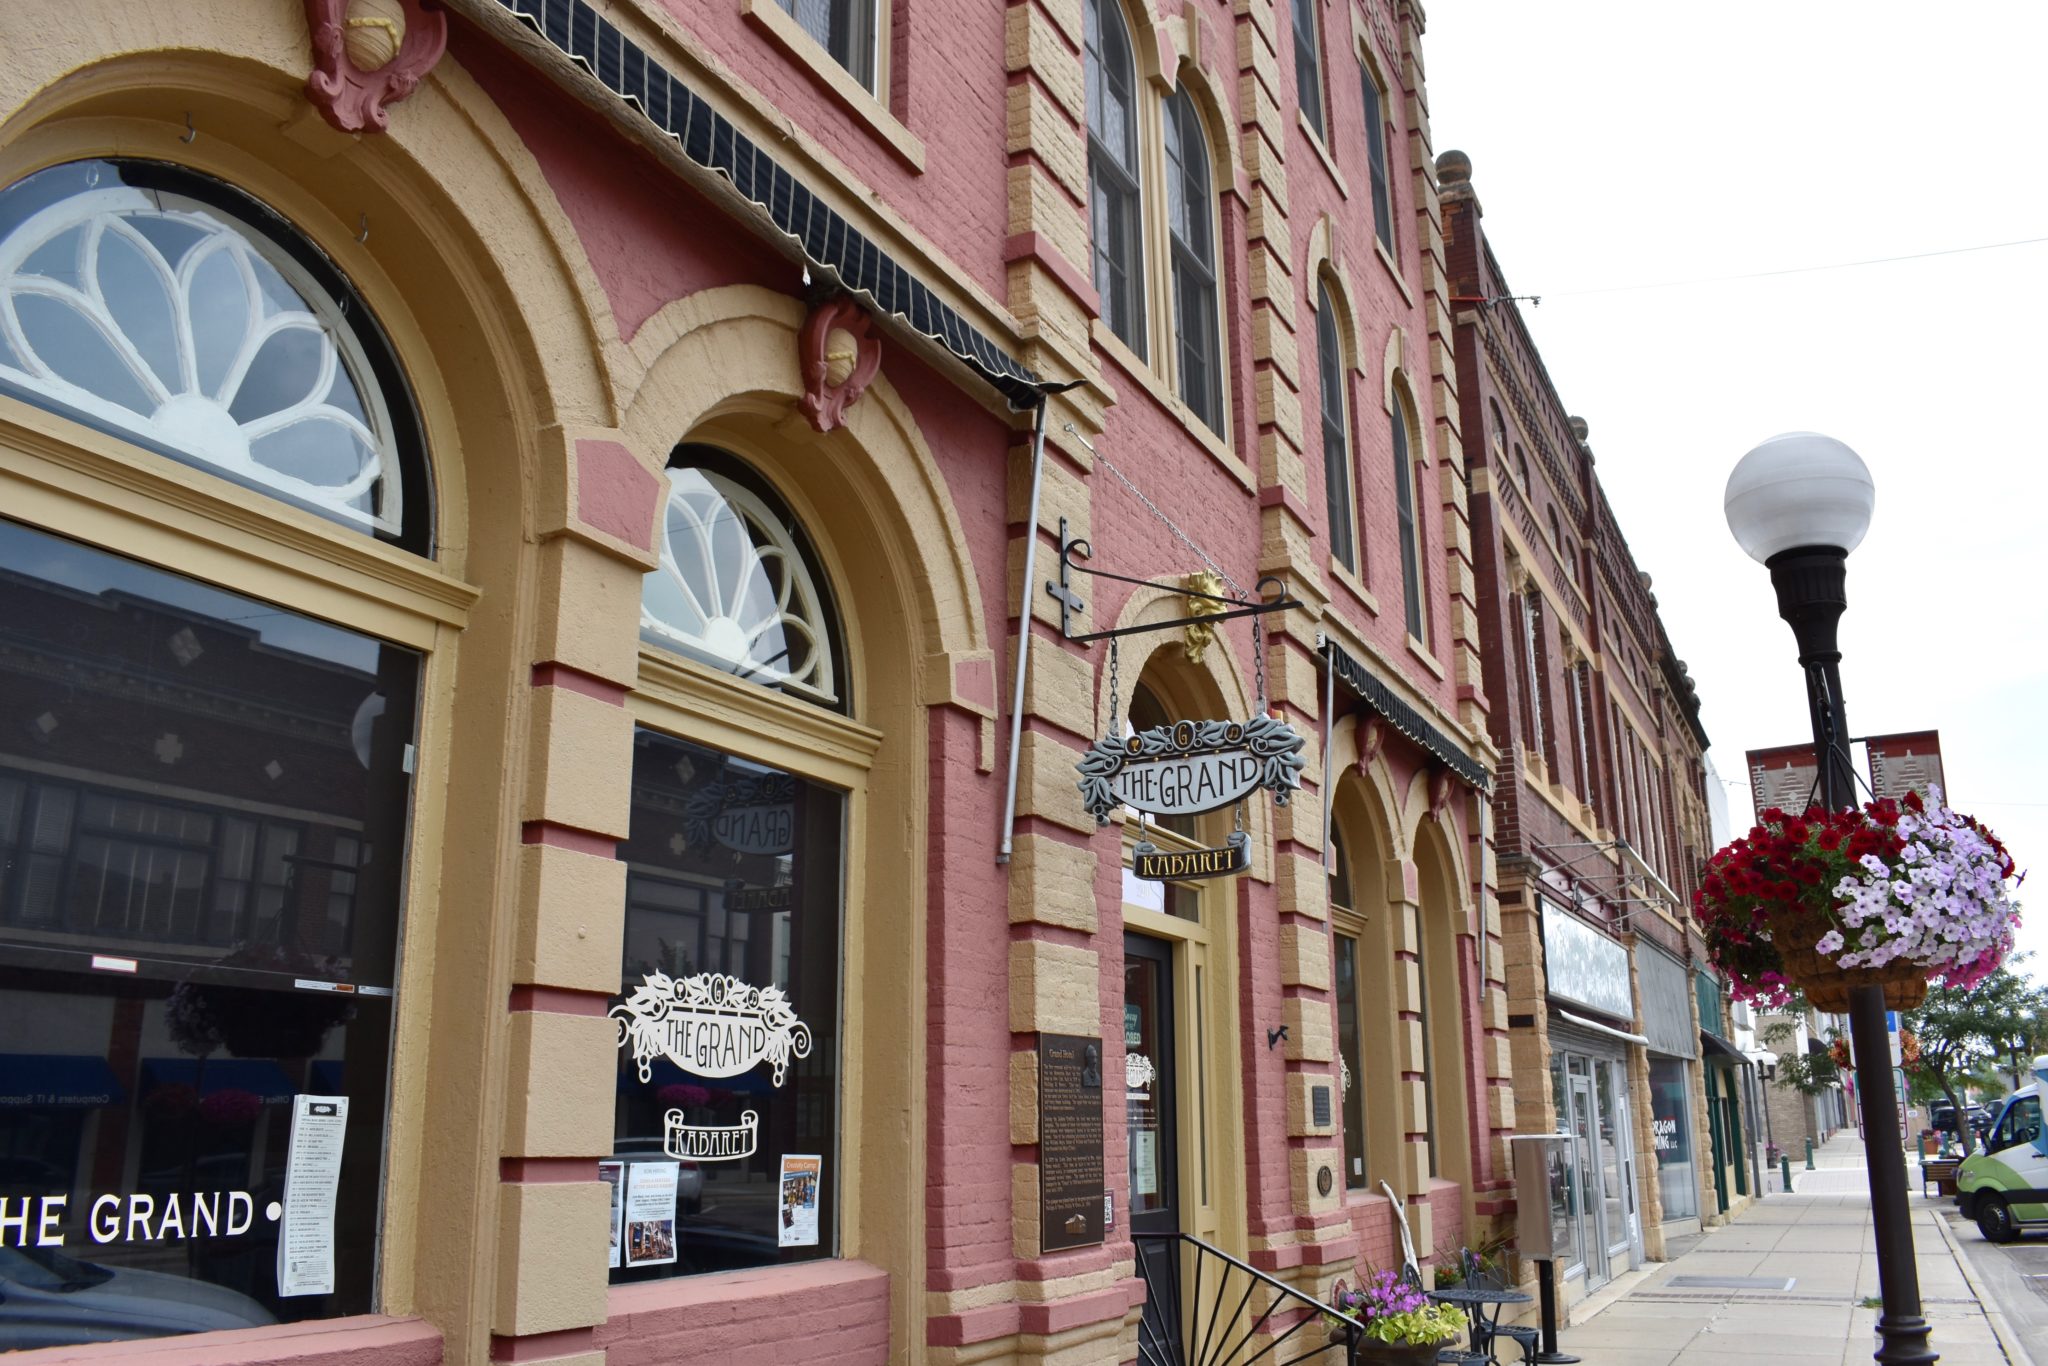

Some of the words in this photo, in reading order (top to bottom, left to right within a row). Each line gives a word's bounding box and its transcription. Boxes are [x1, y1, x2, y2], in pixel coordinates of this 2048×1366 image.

[1177, 724, 1188, 746] G
[1120, 769, 1154, 802] THE
[1160, 757, 1258, 808] GRAND
[1751, 764, 1767, 813] Historic
[1142, 849, 1235, 876] KABARET
[666, 1019, 693, 1059] THE
[696, 1021, 766, 1069] GRAND
[674, 1129, 749, 1156] KABARET
[1654, 1135, 1670, 1150] MING
[0, 1193, 67, 1248] HE
[90, 1191, 254, 1244] GRAND
